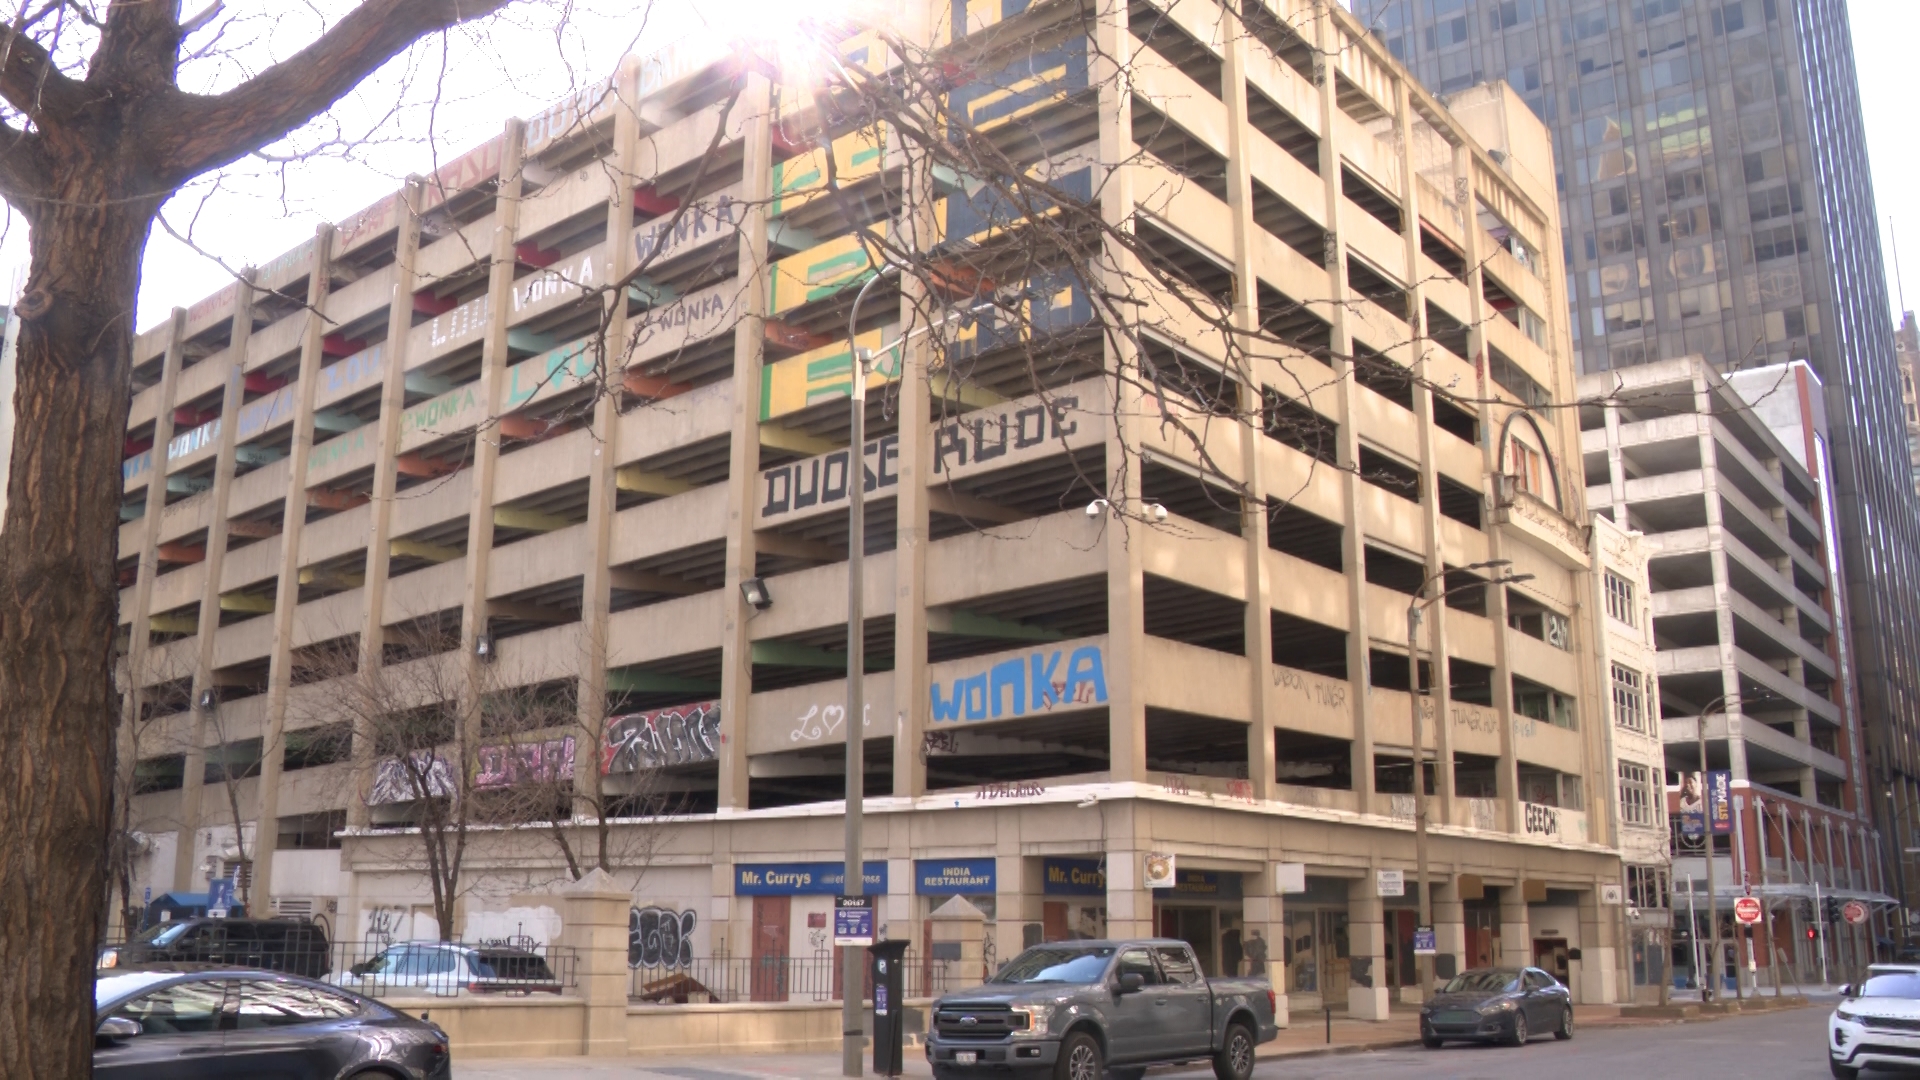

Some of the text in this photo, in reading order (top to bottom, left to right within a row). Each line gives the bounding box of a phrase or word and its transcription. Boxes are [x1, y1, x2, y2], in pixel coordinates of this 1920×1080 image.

[635, 195, 734, 261] WONKA
[512, 256, 592, 312] WONKA
[660, 294, 724, 331] WONKA
[415, 388, 475, 429] WONKA
[168, 417, 222, 460] WONKA
[934, 396, 1078, 475] RUDE
[931, 645, 1108, 722] WONKA
[1525, 802, 1556, 836] GEECH
[741, 871, 762, 886] Mr.
[766, 871, 811, 888] Currys
[924, 876, 990, 886] RESTAURANT
[943, 867, 971, 876] INDIA
[1048, 867, 1105, 888] Mr. Curry
